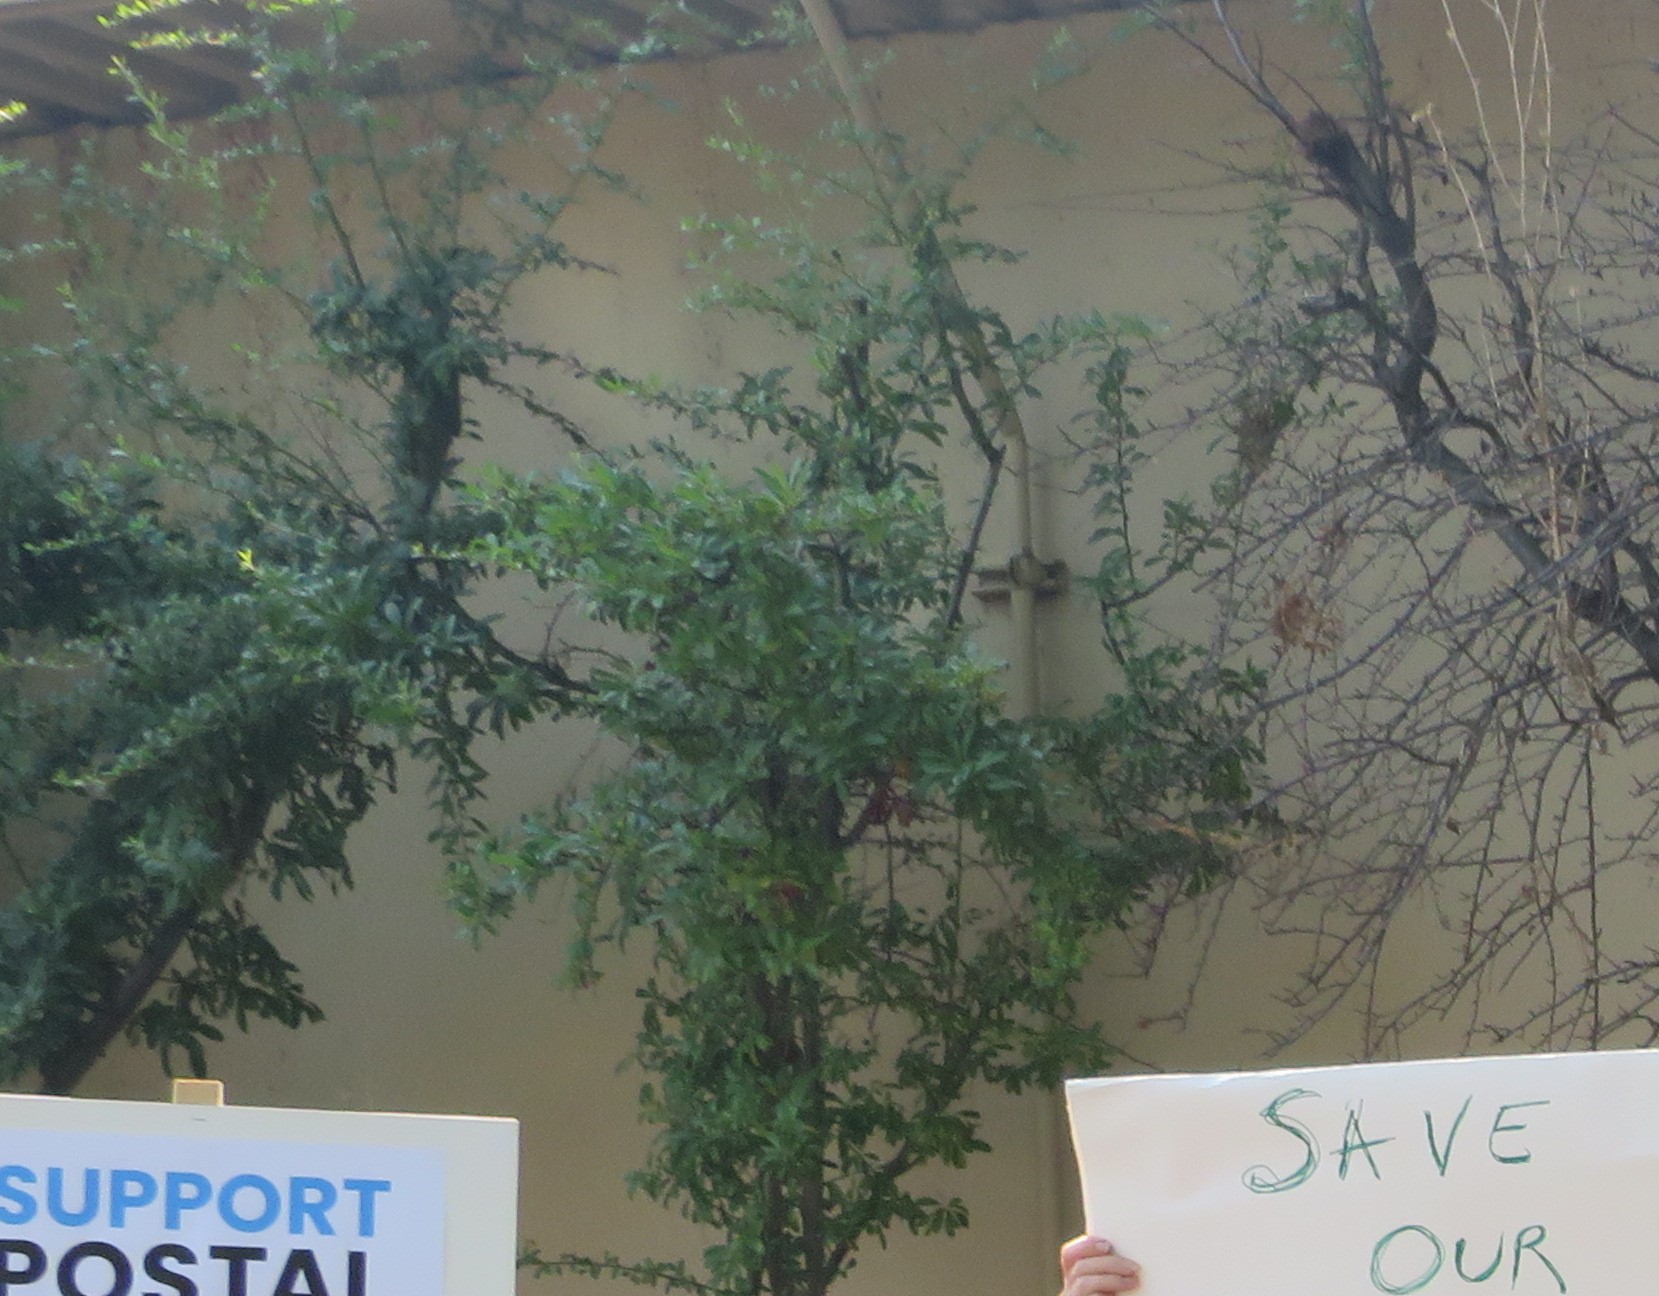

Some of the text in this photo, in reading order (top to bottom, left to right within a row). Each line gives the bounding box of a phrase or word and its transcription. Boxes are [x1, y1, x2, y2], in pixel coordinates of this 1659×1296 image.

[1241, 1088, 1551, 1194] SAVE
[0, 1163, 391, 1238] SUPPORT
[1370, 1223, 1568, 1296] OUR
